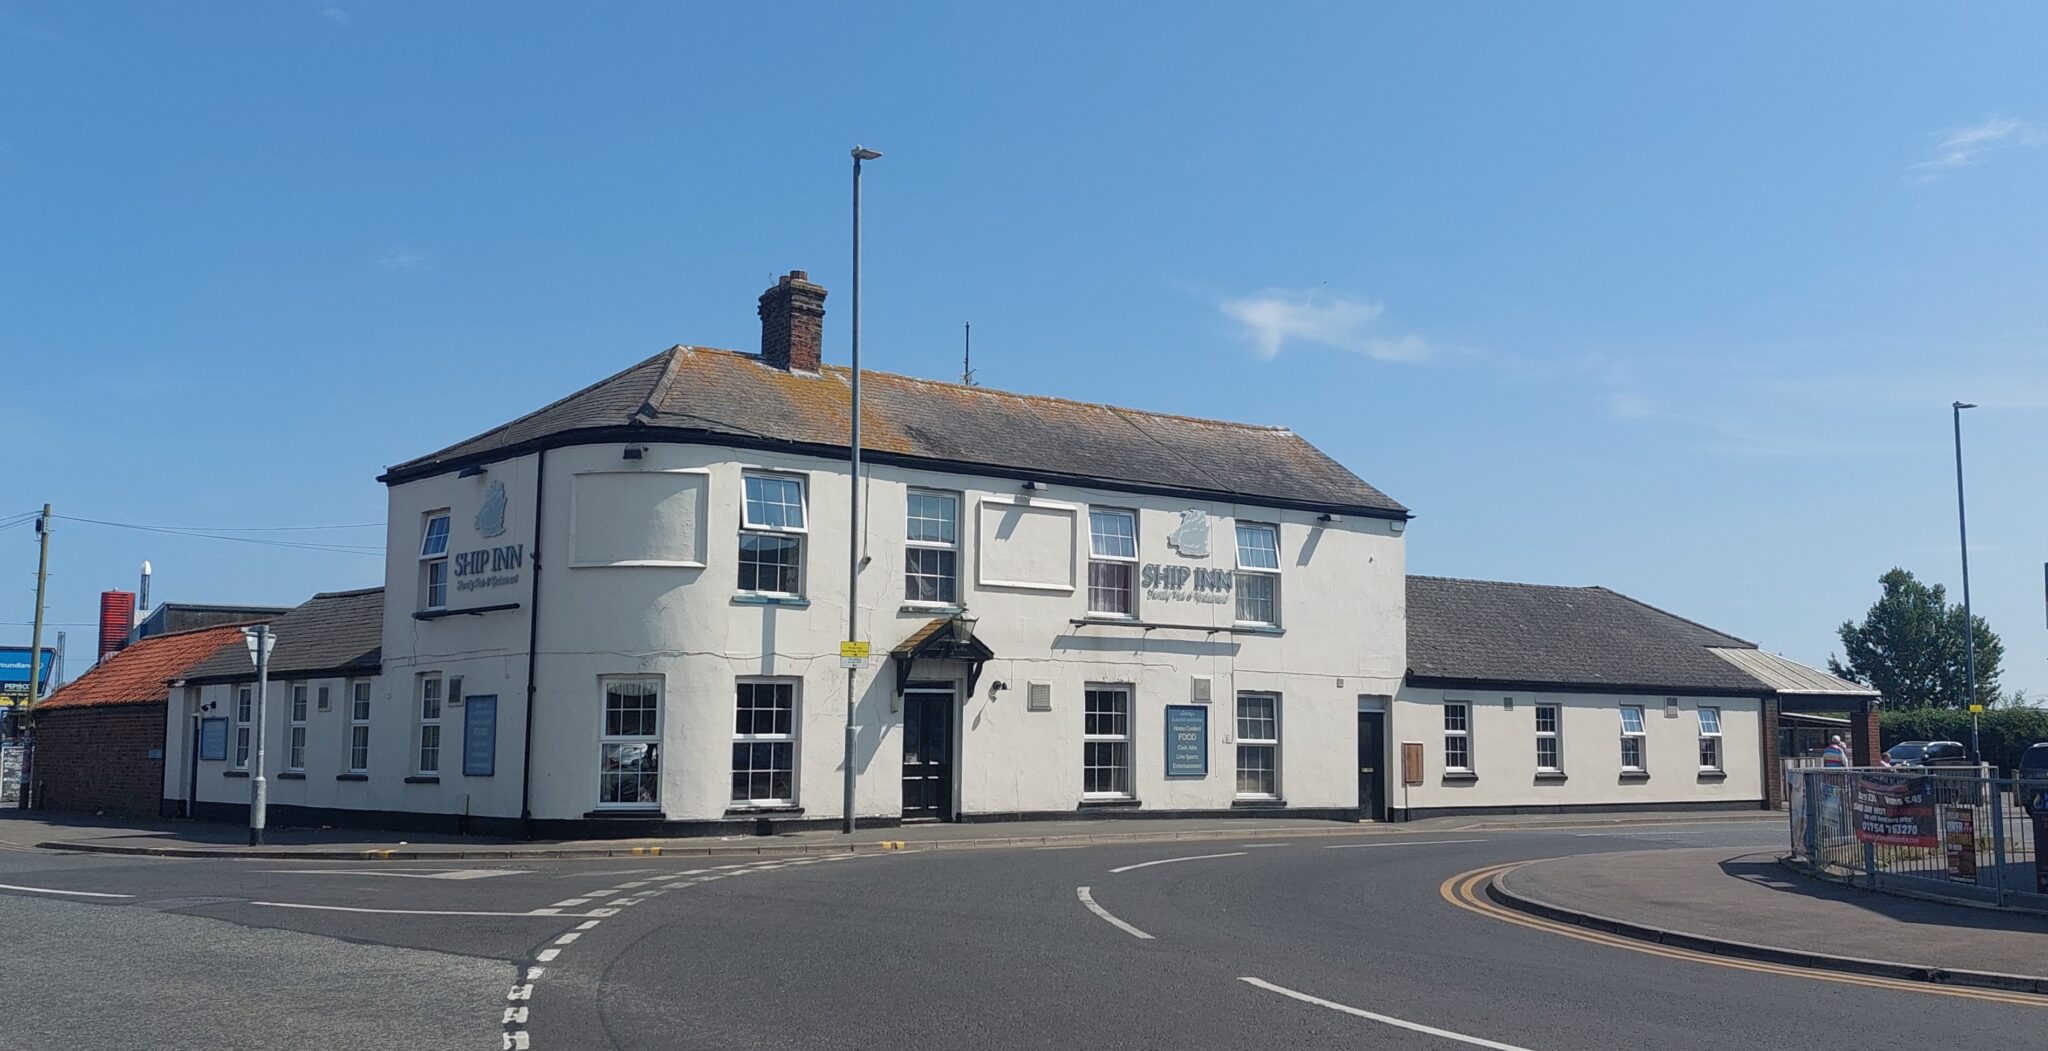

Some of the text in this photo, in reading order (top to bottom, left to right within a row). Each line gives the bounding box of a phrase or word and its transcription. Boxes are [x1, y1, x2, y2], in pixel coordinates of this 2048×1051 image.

[454, 543, 523, 576] SHIP INN
[1141, 563, 1232, 593] SHIP INN
[1178, 733, 1197, 741] FOOD
[1862, 821, 1885, 833] 01754
